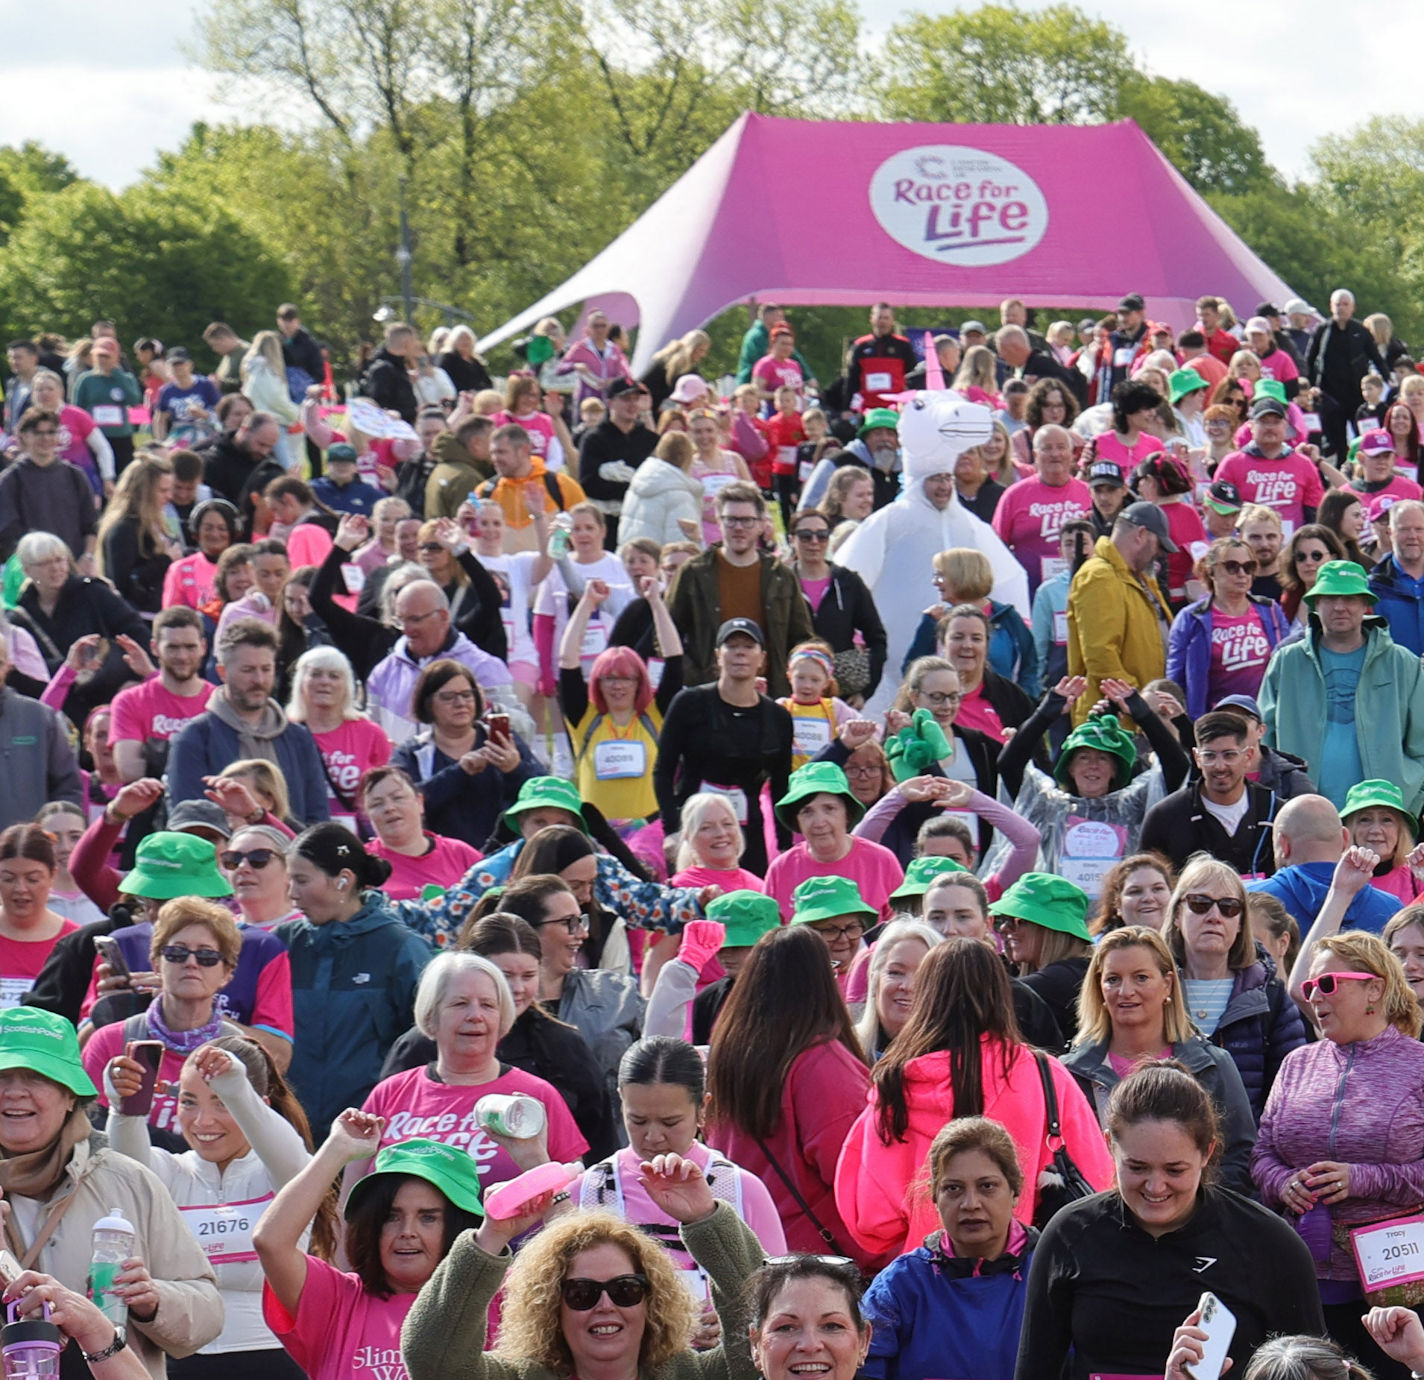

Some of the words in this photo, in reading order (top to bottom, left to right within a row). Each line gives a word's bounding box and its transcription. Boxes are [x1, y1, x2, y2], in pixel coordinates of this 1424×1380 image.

[893, 178, 971, 205] Race
[979, 178, 1017, 199] for
[925, 200, 1031, 241] Life
[1246, 469, 1277, 485] Race
[1279, 471, 1294, 481] for
[1255, 480, 1296, 503] Life
[1029, 502, 1062, 518] Race
[1064, 500, 1082, 512] for
[1211, 626, 1243, 646] Race
[1244, 625, 1262, 636] for
[1221, 635, 1269, 667] Life
[330, 750, 356, 766] for
[384, 1111, 457, 1141] Race
[199, 1217, 249, 1237] 21676
[1385, 1230, 1406, 1240] Tracy
[1383, 1242, 1420, 1261] 20511
